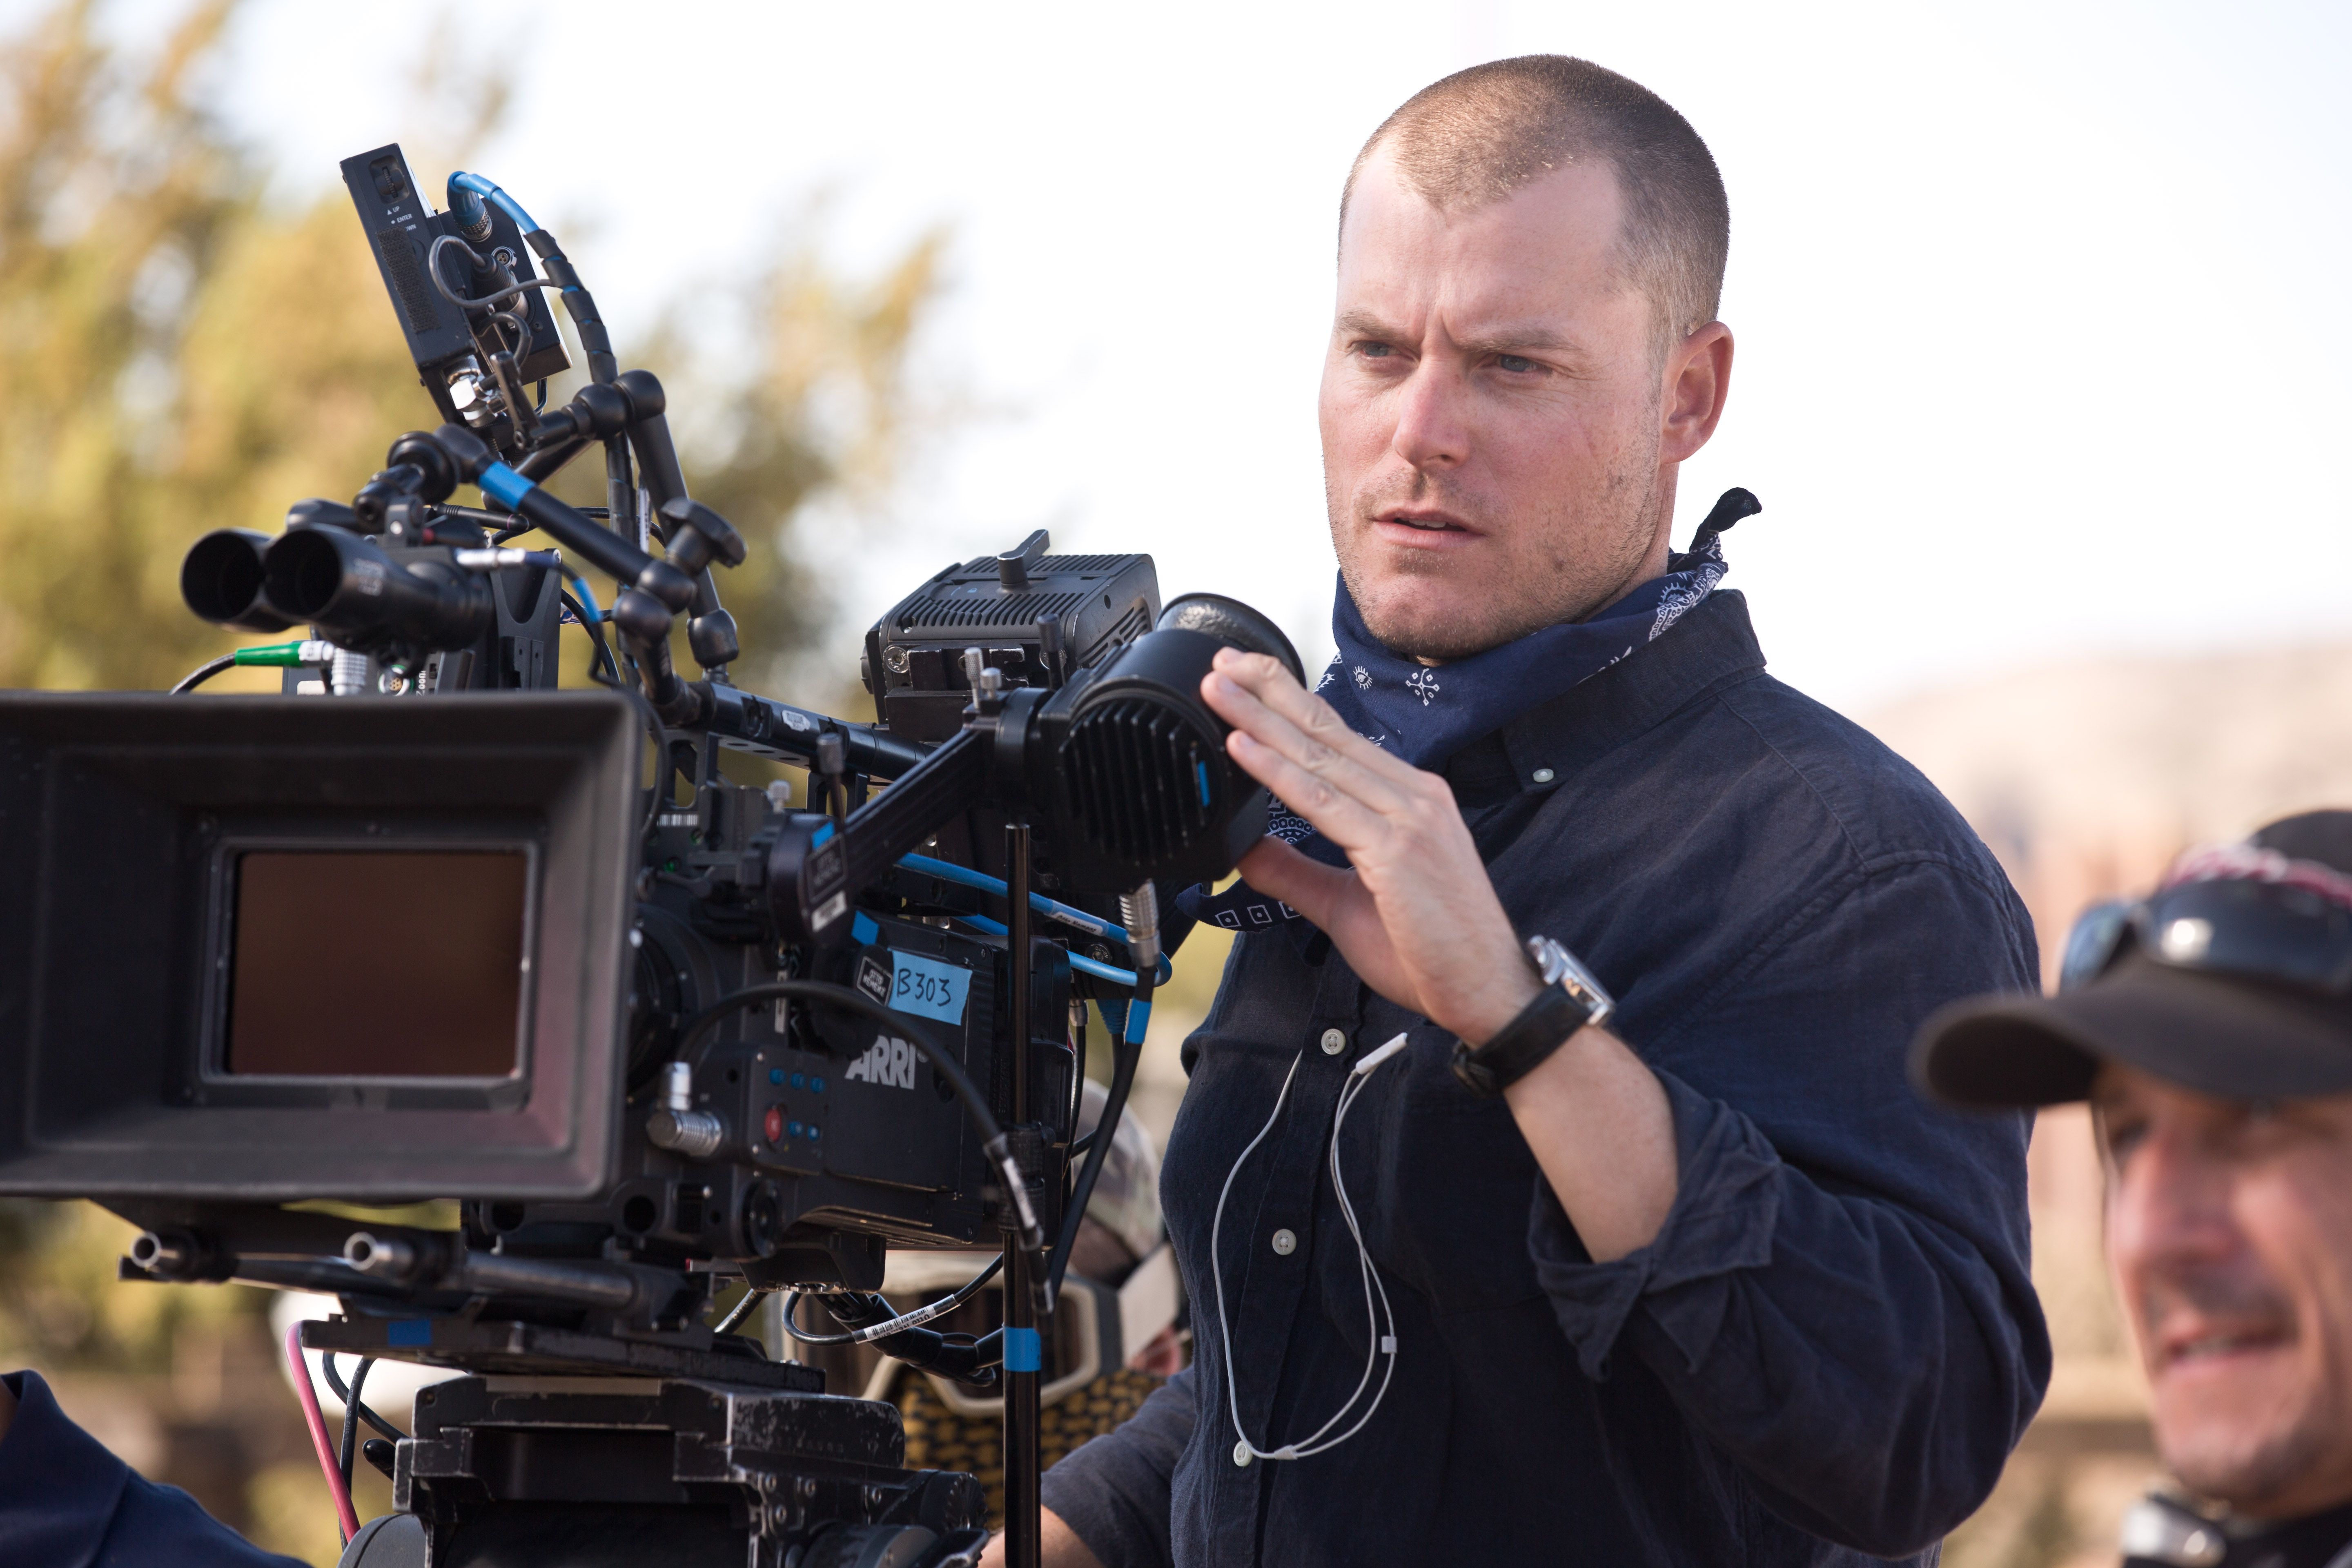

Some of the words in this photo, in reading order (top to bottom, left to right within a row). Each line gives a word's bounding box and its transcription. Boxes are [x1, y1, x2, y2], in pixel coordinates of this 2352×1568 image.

[397, 214, 412, 223] ENTER
[897, 968, 951, 1007] B303
[844, 1034, 916, 1090] ARRI
